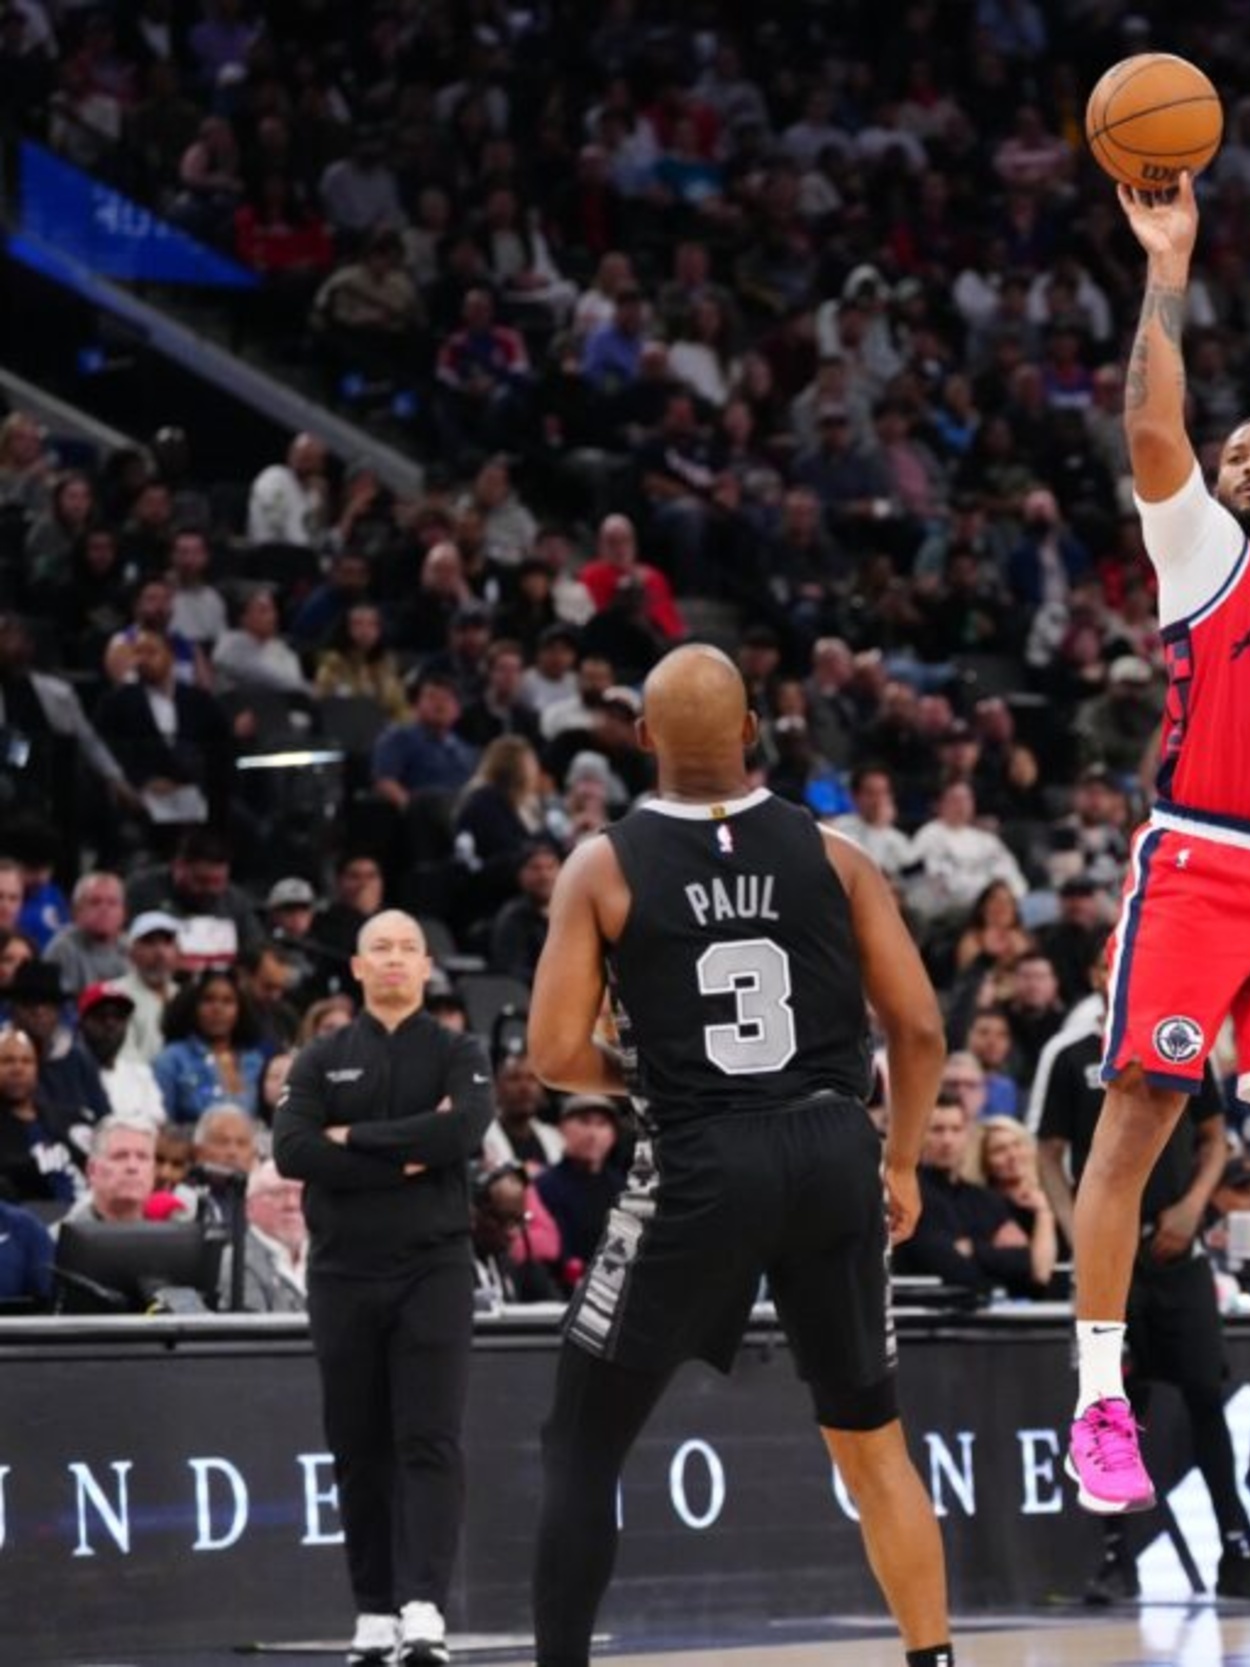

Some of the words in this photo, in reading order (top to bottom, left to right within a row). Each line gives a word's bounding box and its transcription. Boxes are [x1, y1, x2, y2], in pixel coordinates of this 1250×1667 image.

[685, 875, 779, 926] PAUL
[696, 938, 797, 1075] 3
[0, 1453, 346, 1556] NDE
